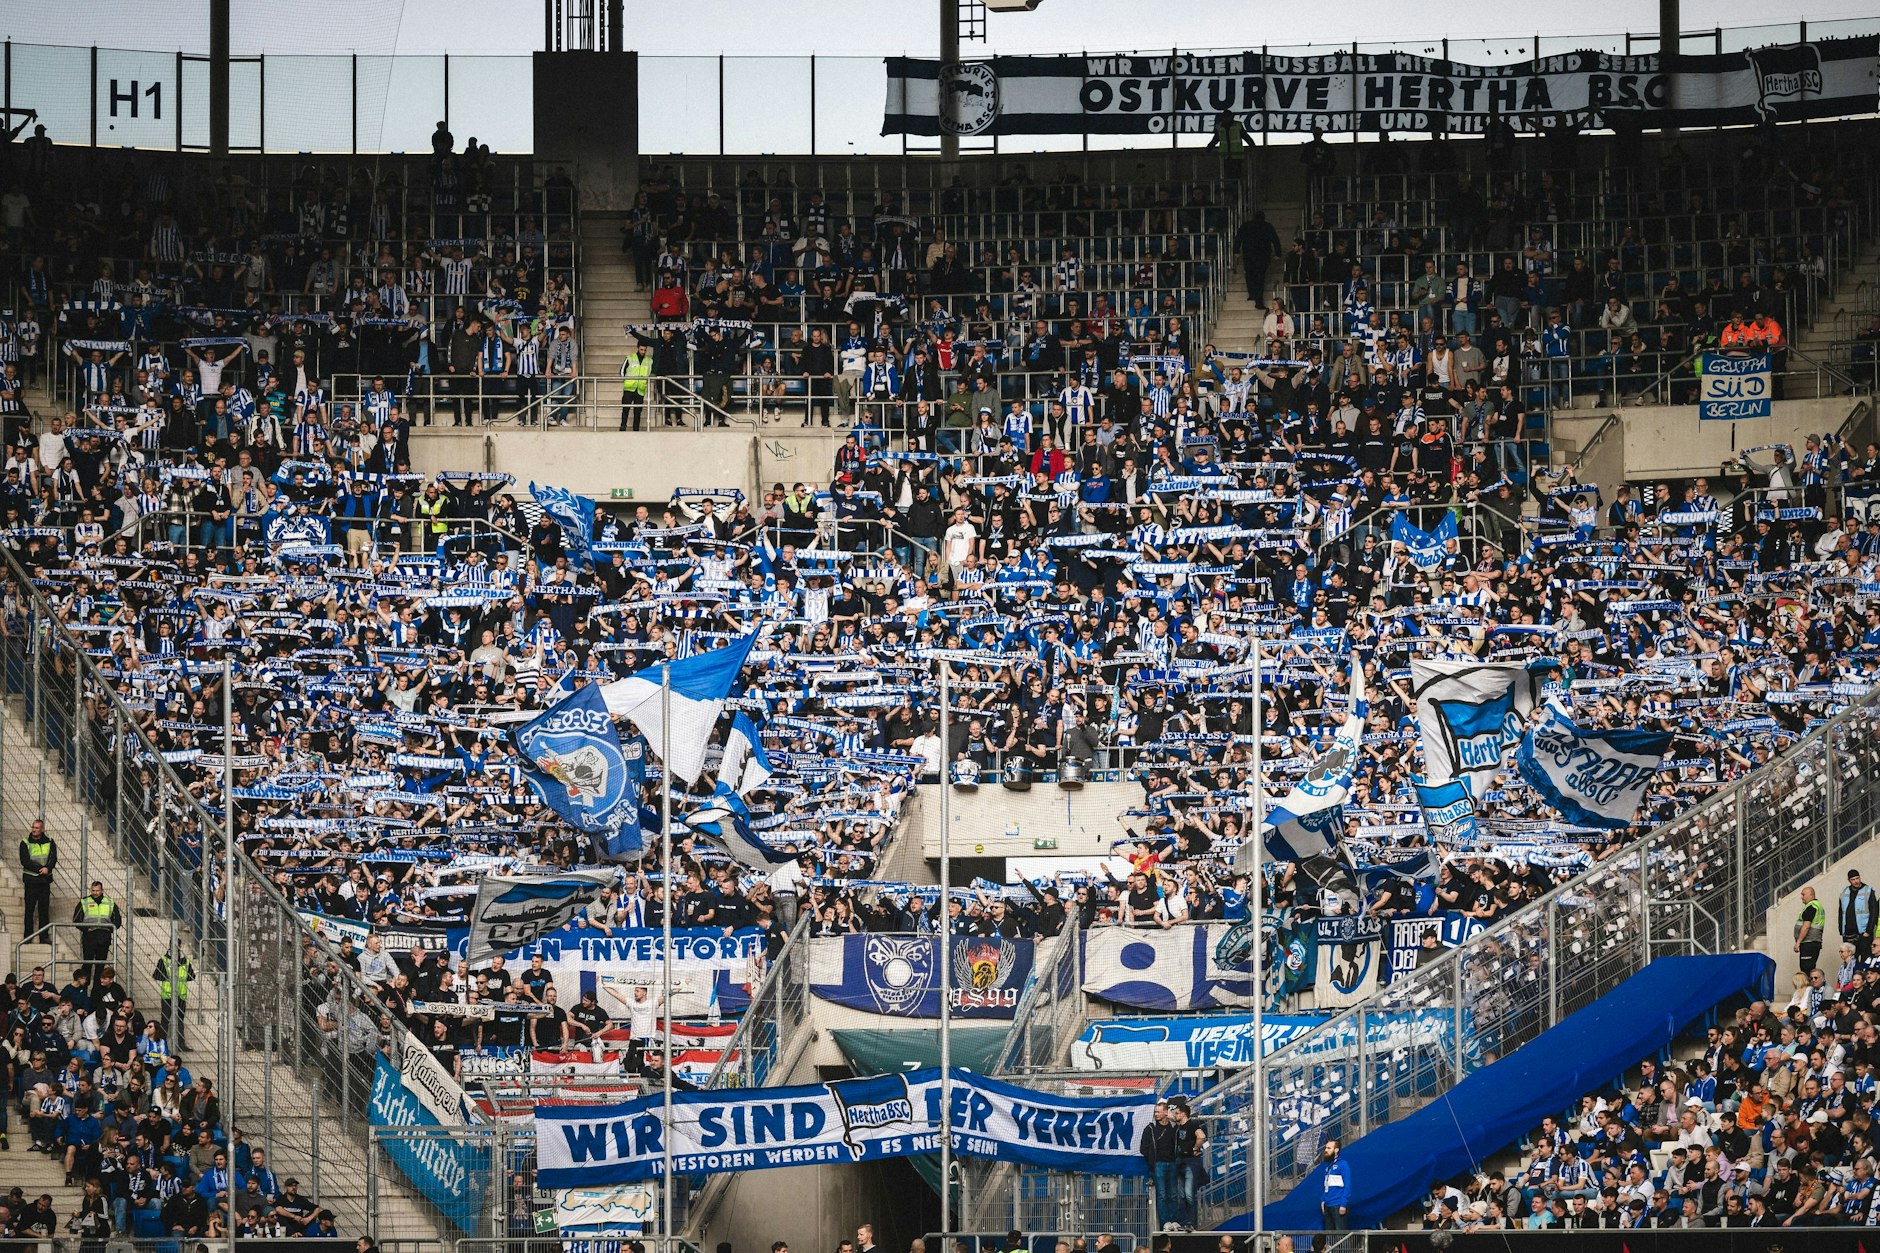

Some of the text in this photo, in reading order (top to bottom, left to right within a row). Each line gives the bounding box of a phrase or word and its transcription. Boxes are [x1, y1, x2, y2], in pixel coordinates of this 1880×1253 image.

[1086, 57, 1134, 76] WIR
[1149, 56, 1245, 76] WOLLEN
[1261, 54, 1378, 75] FUSSBALL
[1395, 54, 1435, 73] MIT
[1532, 54, 1582, 74] UND
[1079, 74, 1672, 112] OSTKURVE HERTHA BSC
[109, 79, 162, 120] H1
[1147, 114, 1214, 133] OHNE
[1379, 112, 1429, 130] UND
[1706, 377, 1765, 398] SÜD
[1706, 400, 1763, 417] BERLIN
[679, 488, 738, 497] HERTHA BSC
[1208, 490, 1265, 501] OSTKURVE
[1662, 512, 1717, 523] OSTKURVE
[1053, 533, 1113, 546] OSTKURVE
[1258, 539, 1293, 549] BERLIN
[1132, 563, 1191, 575] OSTKURVE
[162, 572, 199, 583] HERTHA
[120, 580, 167, 590] OSTKURVE
[532, 585, 600, 597] HERTHA BSC
[1429, 617, 1480, 625] Hertha BSC
[1295, 628, 1344, 637] HERTHA BSC
[1497, 648, 1524, 656] HERTHA
[392, 655, 425, 666] 1892
[789, 718, 809, 728] SIND
[777, 729, 798, 738] BSC
[1160, 732, 1230, 741] HERTHA BSC
[1364, 730, 1420, 741] HERTHA BSC
[397, 758, 456, 769] OSTKURVE
[1453, 799, 1472, 818] BSC
[389, 828, 424, 837] HERTHA
[424, 826, 442, 836] BSC
[560, 1113, 666, 1164] WIR
[699, 1102, 827, 1148] SIND
[848, 1106, 888, 1126] Hertha
[887, 1101, 910, 1120] BSC
[1011, 1105, 1135, 1152] VEREIN
[651, 1137, 999, 1175] INVESTOREN WERDEN ES SEIN!
[1100, 1181, 1111, 1194] G2
